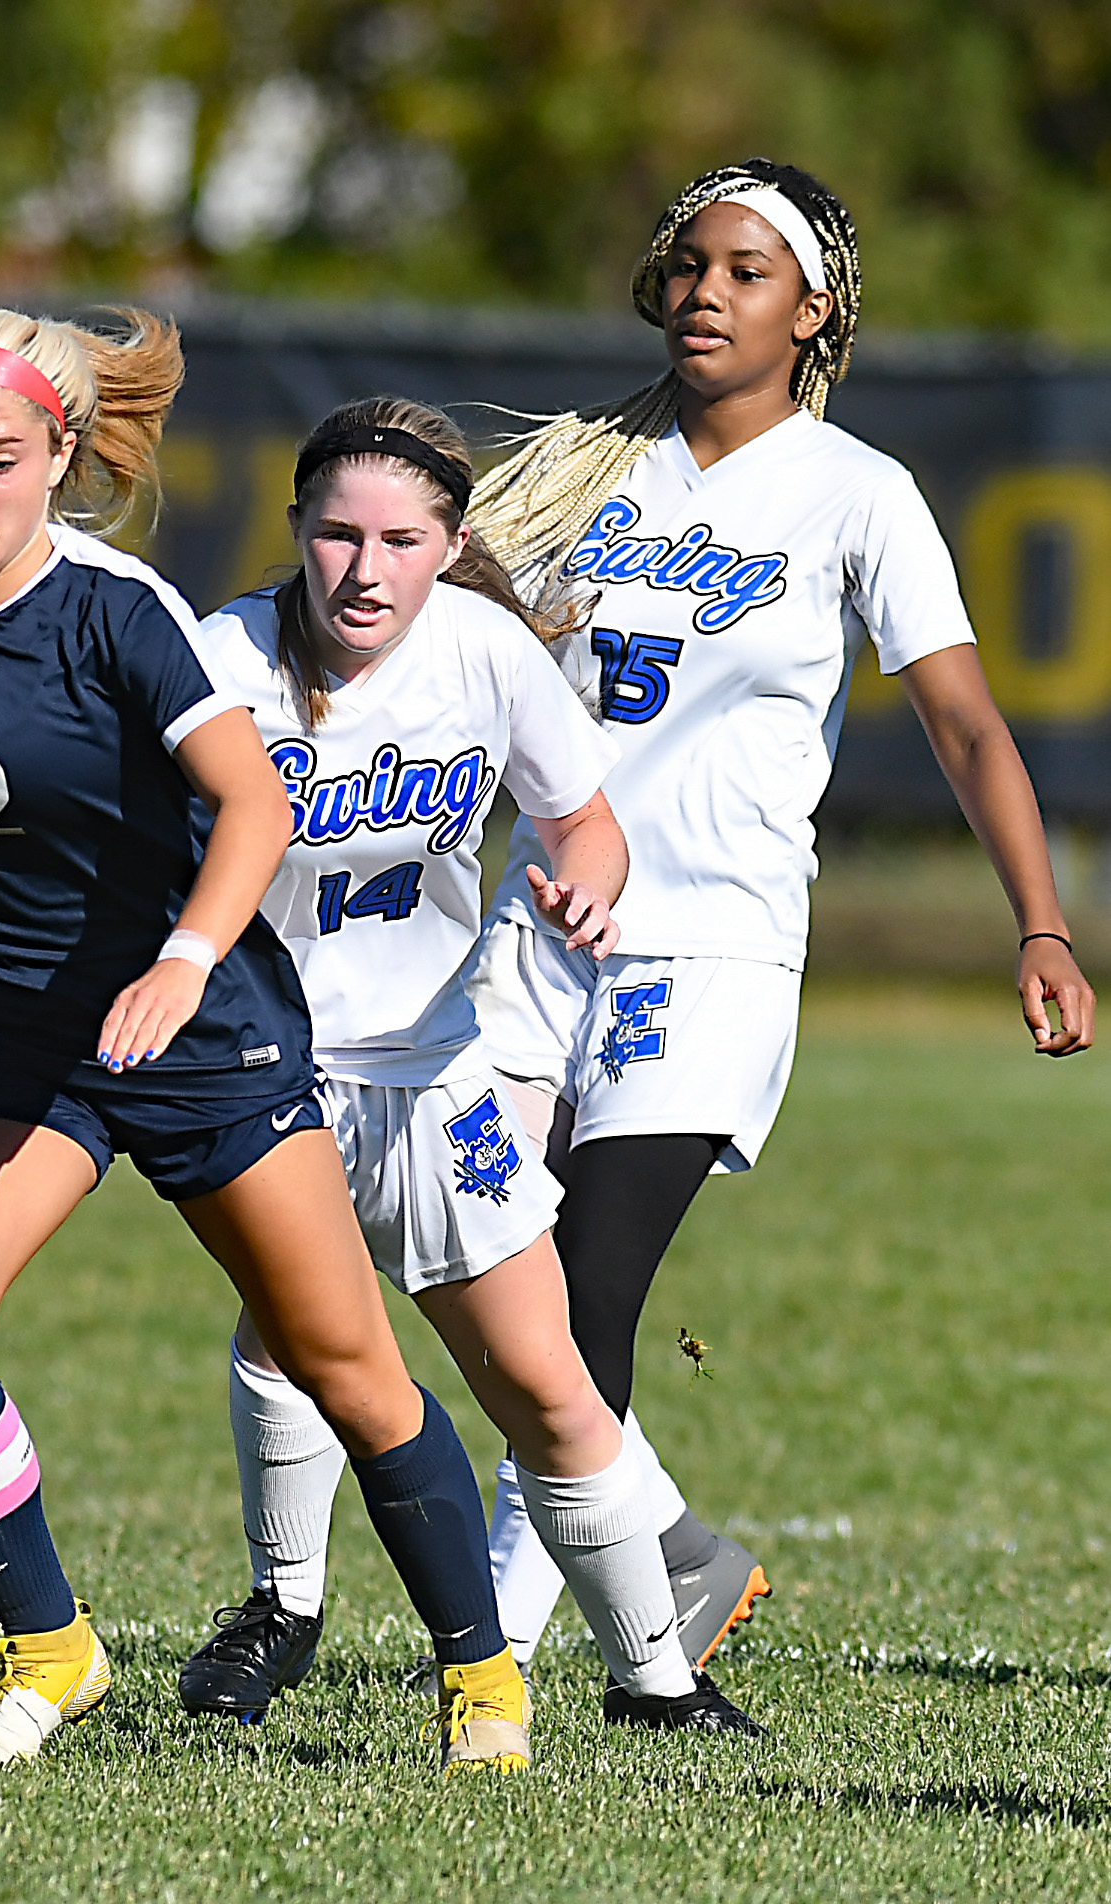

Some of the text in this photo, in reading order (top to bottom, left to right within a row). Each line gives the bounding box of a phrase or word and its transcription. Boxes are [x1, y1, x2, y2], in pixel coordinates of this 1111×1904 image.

[562, 495, 788, 635] Ewing
[591, 627, 685, 725] 15
[267, 738, 496, 856] Ewing
[317, 861, 424, 936] 14
